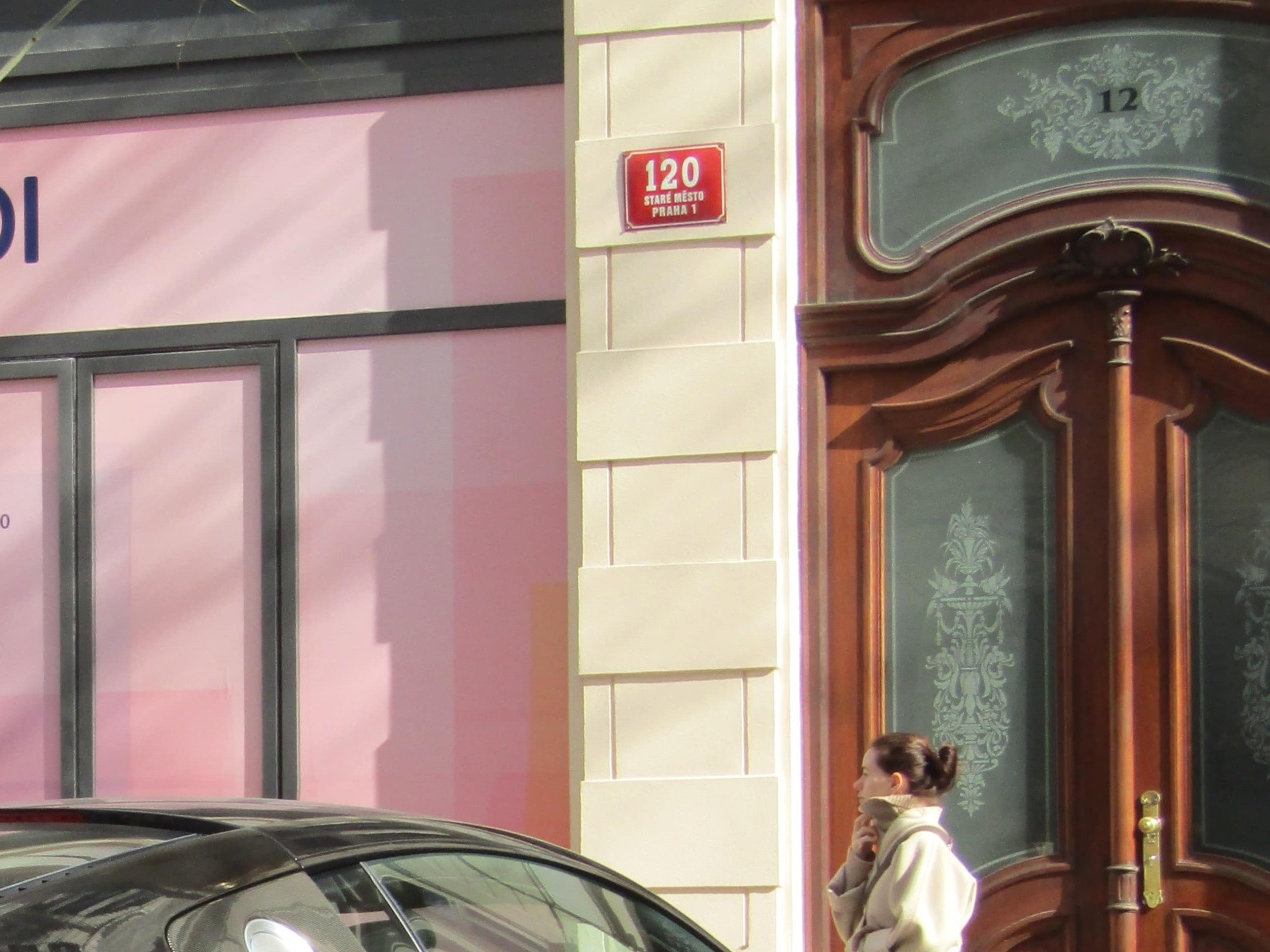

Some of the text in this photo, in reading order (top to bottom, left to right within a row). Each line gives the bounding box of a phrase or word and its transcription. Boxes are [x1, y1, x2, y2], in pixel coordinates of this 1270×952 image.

[1098, 87, 1138, 113] 12
[645, 156, 700, 192] 120
[644, 190, 704, 206] STARÉ MĚSTO
[652, 204, 697, 218] PRAHA 1
